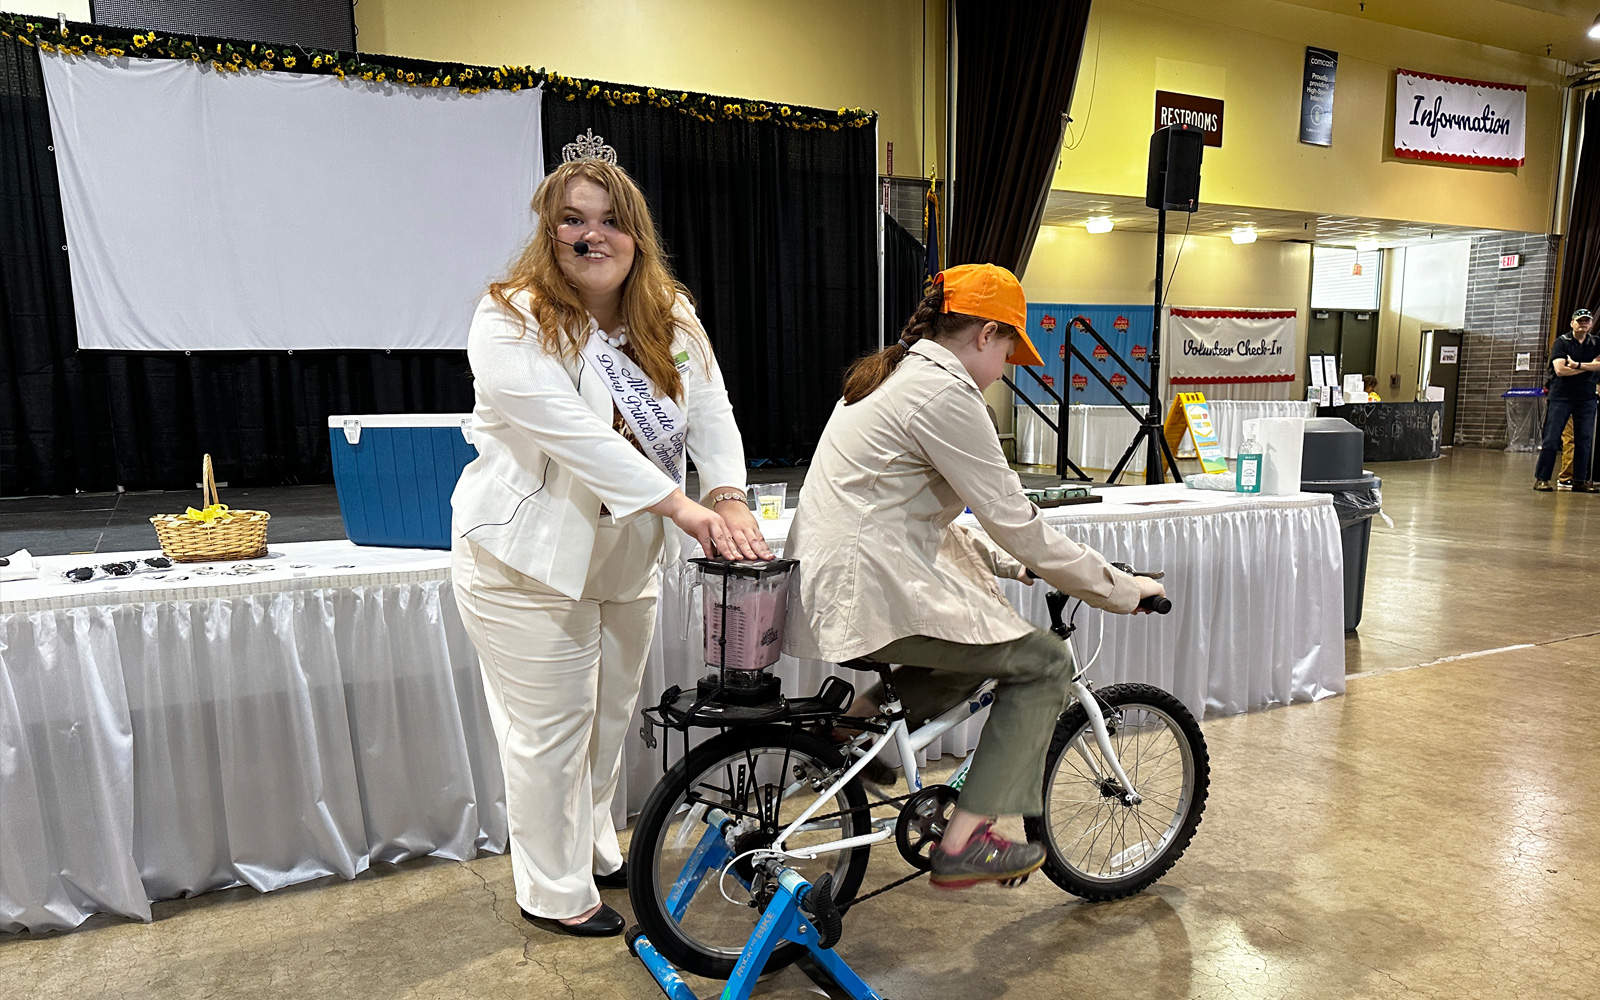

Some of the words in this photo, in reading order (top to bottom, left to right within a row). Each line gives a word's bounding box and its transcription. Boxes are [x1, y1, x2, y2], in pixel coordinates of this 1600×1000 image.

[1311, 58, 1334, 67] comcast
[1309, 80, 1329, 89] providing
[1311, 72, 1328, 82] Proudly
[1161, 106, 1218, 132] RESTROOMS
[1409, 95, 1510, 138] Information
[1503, 255, 1516, 267] EXIT
[1183, 339, 1234, 357] Volunteer
[1236, 339, 1283, 356] Check-In
[621, 368, 675, 432] Alternate
[596, 354, 625, 393] Dairy
[621, 395, 658, 442] Princess
[653, 443, 682, 484] Ambass
[736, 950, 753, 977] ROCK
[755, 911, 775, 939] BIKE
